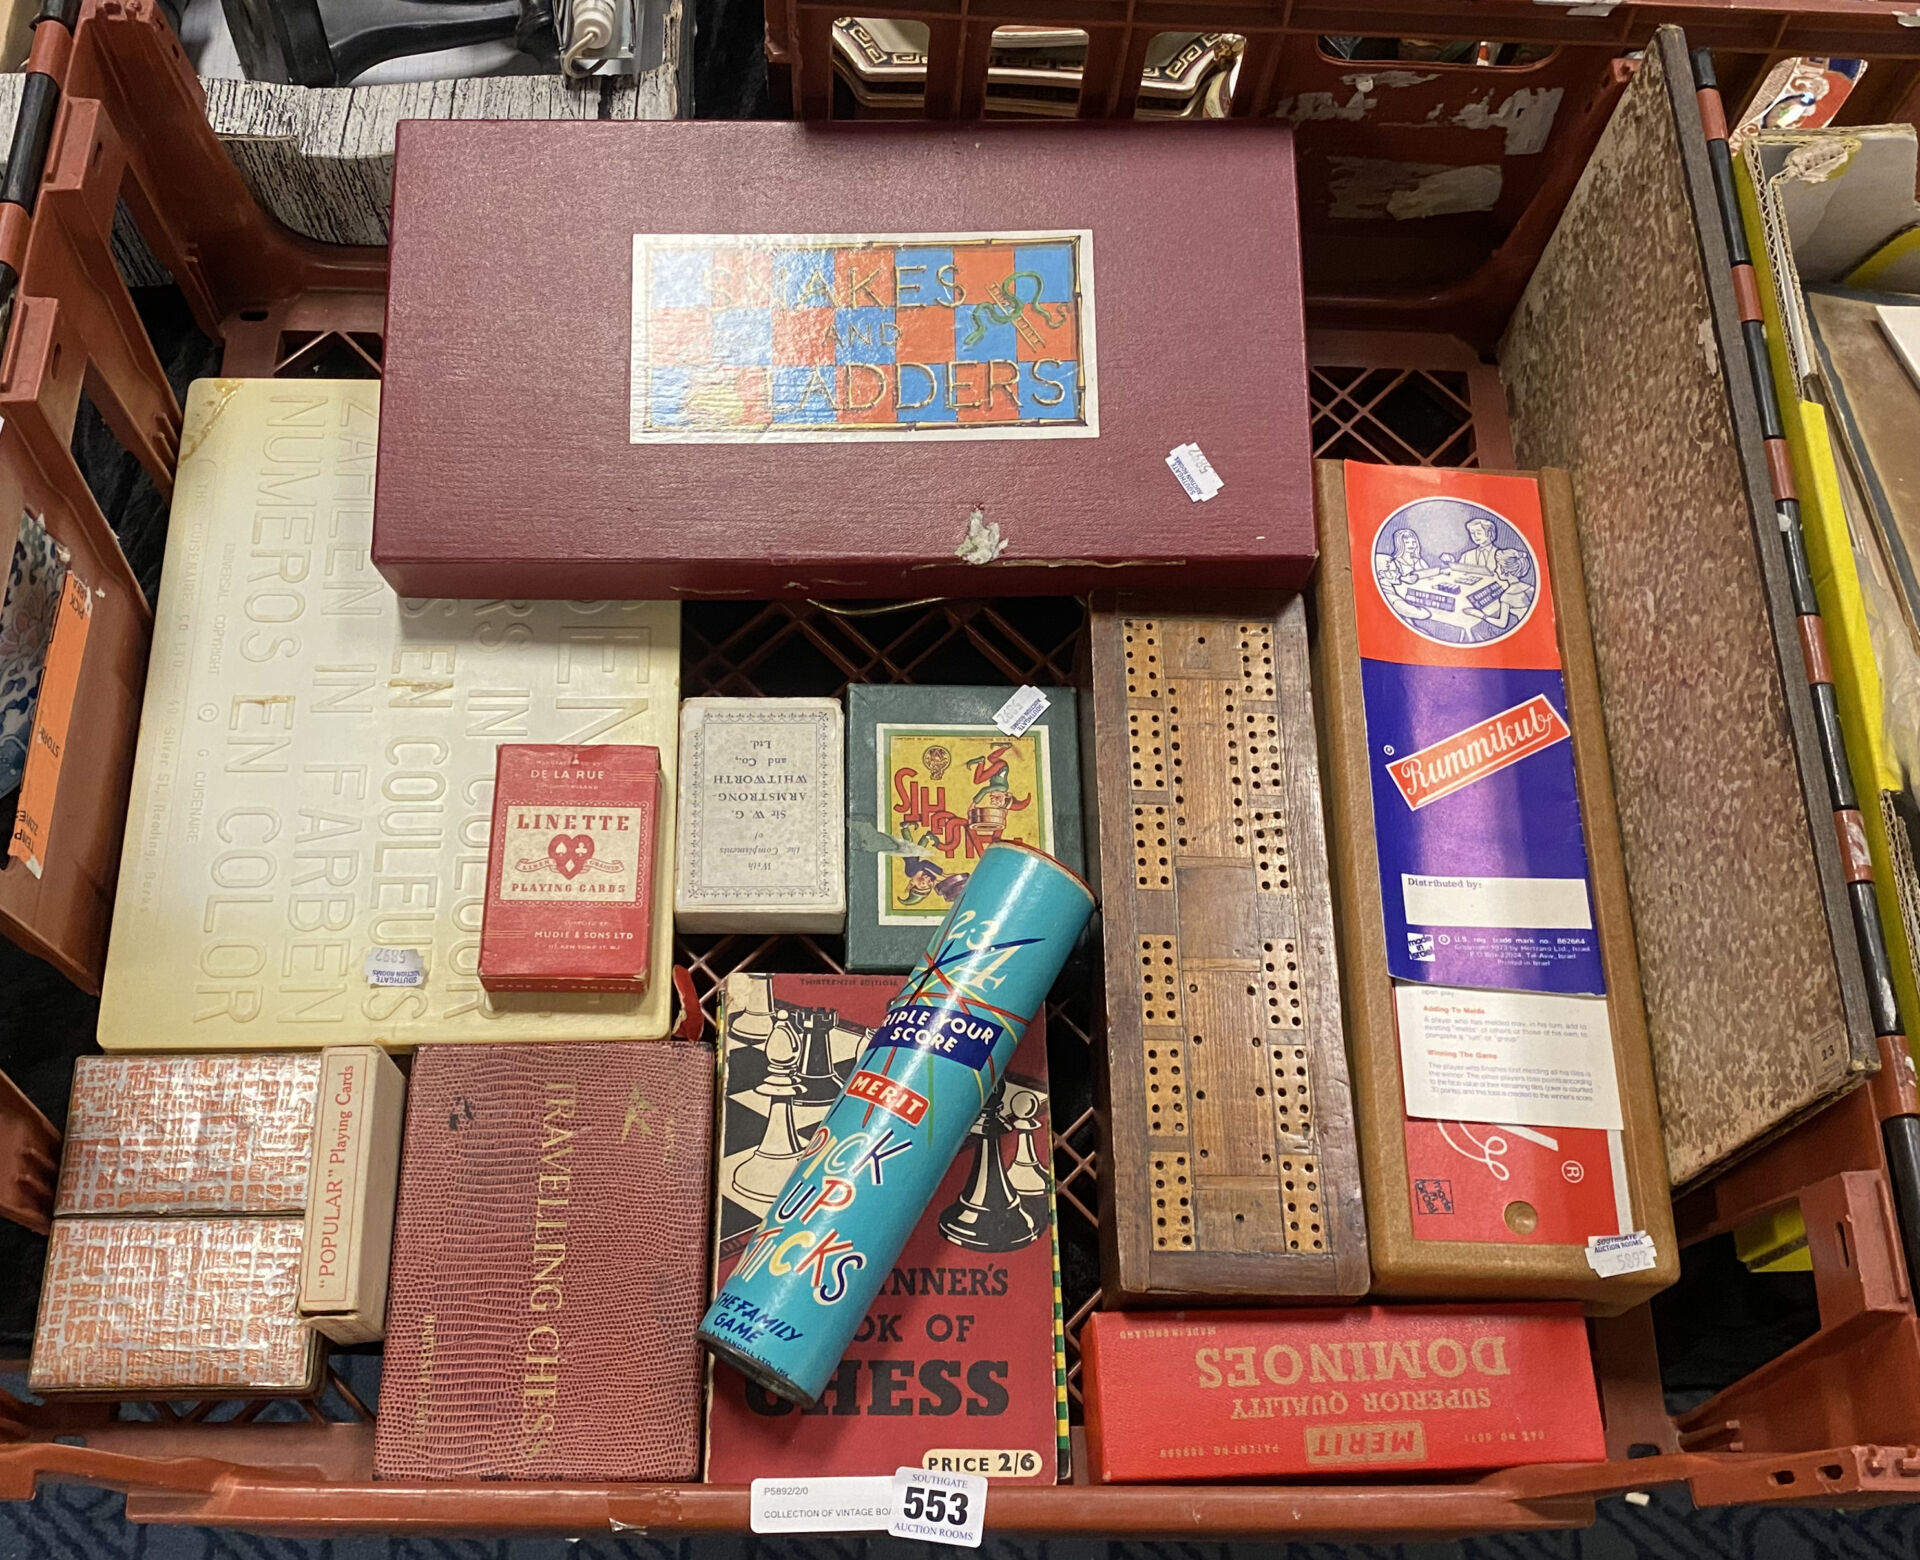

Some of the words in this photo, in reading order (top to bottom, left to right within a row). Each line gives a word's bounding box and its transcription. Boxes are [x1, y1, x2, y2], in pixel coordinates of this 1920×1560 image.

[703, 263, 967, 311] SNAKES
[822, 321, 903, 347] AND
[767, 357, 1066, 413] LADDERS
[1171, 463, 1196, 495] SOUTHGATE
[239, 395, 328, 663] NUMEROS
[310, 664, 375, 714] IN
[388, 651, 455, 708] EN
[465, 689, 530, 737] IN
[224, 694, 295, 773] EN
[750, 740, 771, 748] Ltd.
[768, 757, 787, 766] and
[1401, 707, 1555, 797] Rummikub
[531, 769, 548, 779] DE
[554, 769, 570, 780] LA
[576, 770, 605, 780] RUE
[713, 775, 807, 784] WHITWORTH
[185, 771, 207, 843] CUISENAIRE
[711, 791, 807, 801] ARMSTRONG-
[516, 814, 630, 831] LINETTE
[731, 809, 745, 819] G.
[771, 809, 787, 819] Sir
[720, 845, 778, 856] Compliments
[748, 861, 771, 870] With
[276, 765, 366, 1024] FARBEN
[360, 735, 447, 1022] COULEUS
[512, 883, 572, 893] PLAYING
[579, 884, 626, 894] CARDS
[1407, 877, 1463, 889] Distributed
[1466, 879, 1482, 889] by:
[191, 806, 282, 1024] COLOR
[534, 931, 570, 939] MUDIE
[614, 932, 634, 940] LTD
[880, 1008, 931, 1028] RIPLE
[938, 1013, 997, 1046] YOUR
[889, 1026, 958, 1053] SCORE
[334, 1065, 354, 1106] Cards
[851, 1074, 925, 1116] MERIT
[328, 1110, 353, 1165] Playing
[802, 1126, 913, 1186] PICK
[530, 1079, 576, 1312] TRAVELLING
[776, 1176, 857, 1226] UP
[734, 1226, 868, 1306] TICKS
[713, 1312, 764, 1344] GAME
[716, 1291, 741, 1310] THE
[736, 1299, 804, 1342] FAMILY
[852, 1315, 904, 1343] OK
[926, 1315, 975, 1342] OF
[1194, 1336, 1510, 1388] DOMINOES
[519, 1325, 561, 1460] CHESS
[1230, 1390, 1348, 1419] QUALITY
[1361, 1387, 1490, 1413] SUPERIOR
[1312, 1429, 1414, 1457] MERIT
[928, 1457, 990, 1472] PRICE
[998, 1453, 1036, 1473] 2/6
[763, 1486, 809, 1496] P5892/2/0
[911, 1473, 968, 1489] SOUTHGATE
[763, 1510, 820, 1519] COLLECTION
[821, 1509, 834, 1518] OF
[835, 1508, 874, 1518] VINTAGE
[903, 1486, 969, 1526] 553
[894, 1522, 938, 1536] AUCTION
[938, 1527, 974, 1541] ROOMS
